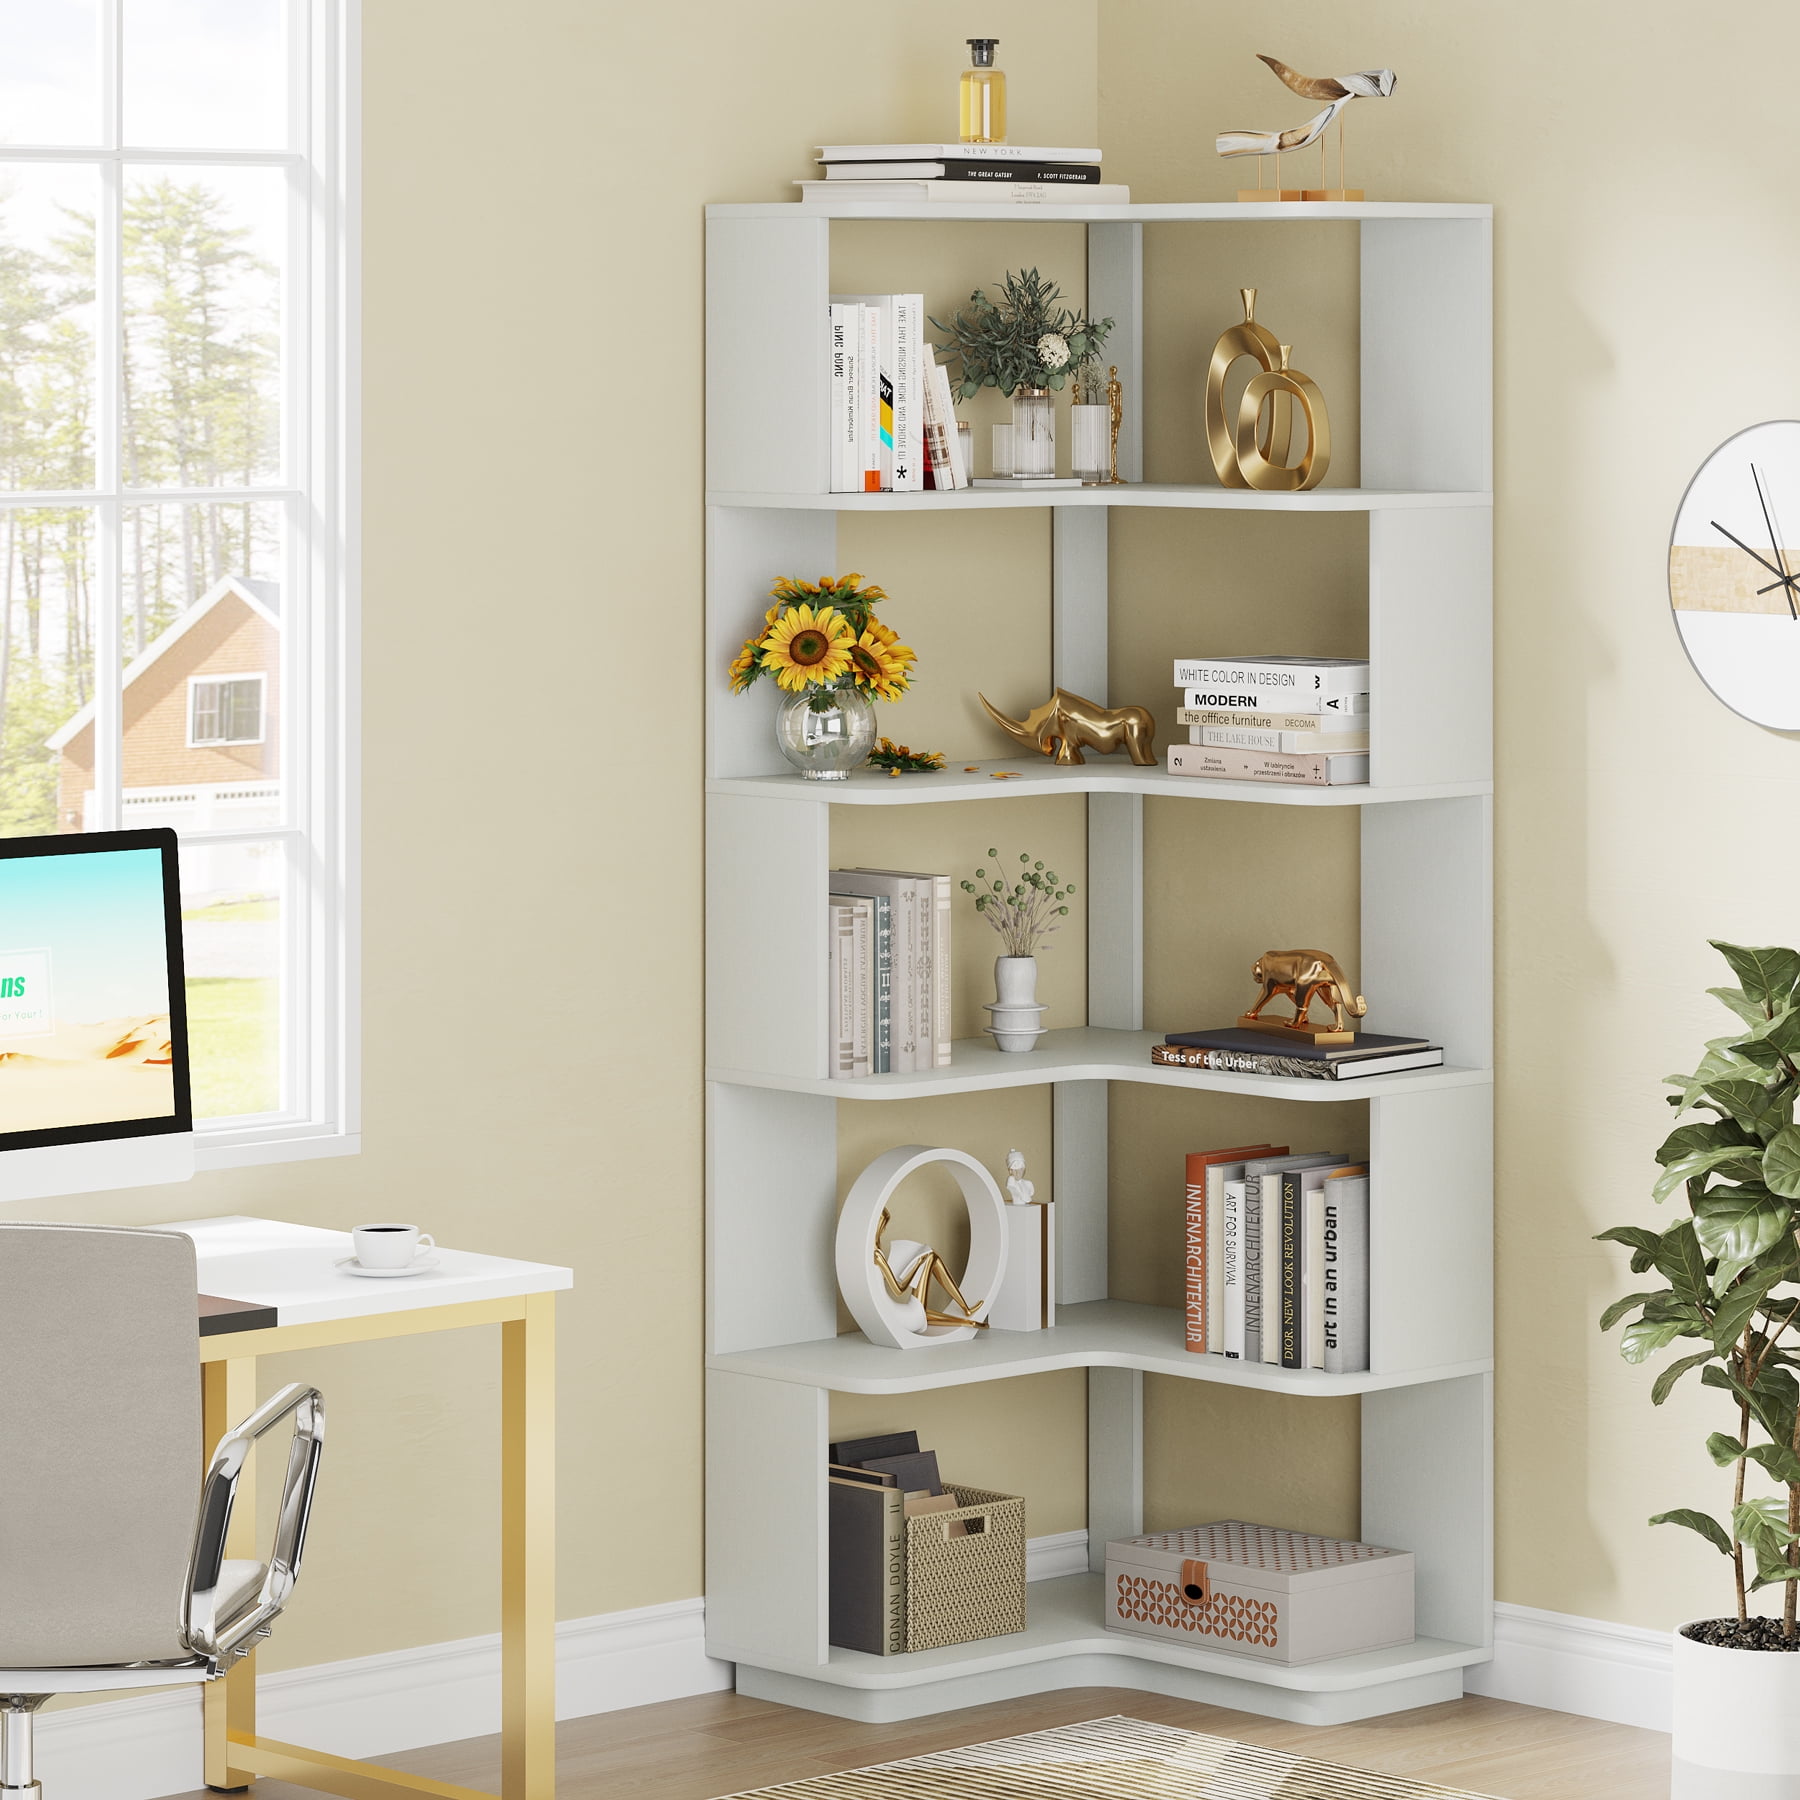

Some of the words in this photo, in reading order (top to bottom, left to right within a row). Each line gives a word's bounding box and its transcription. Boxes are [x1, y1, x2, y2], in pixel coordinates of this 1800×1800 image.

[963, 147, 987, 155] NEW
[994, 148, 1022, 156] YORK
[1179, 667, 1209, 682] WHITE
[1211, 669, 1245, 684] COLOR
[1247, 671, 1257, 684] IN
[1259, 672, 1295, 687] DESIGN
[1194, 694, 1257, 708] MODERN
[1326, 698, 1339, 710] A
[1184, 711, 1200, 723] the
[1232, 713, 1272, 728] furniture
[1285, 718, 1316, 729] DECOMA
[1208, 731, 1224, 743] THE
[1225, 732, 1247, 745] LAKE
[1248, 734, 1276, 748] HOUSE
[1173, 757, 1183, 767] 2
[0, 976, 25, 998] ns
[1161, 1051, 1186, 1063] Tess
[1189, 1053, 1202, 1064] of
[1204, 1054, 1222, 1066] the
[1225, 1057, 1258, 1069] Urber
[1225, 1193, 1237, 1213] ART
[1225, 1216, 1237, 1237] FOR
[1284, 1182, 1294, 1259] REVOLUTION
[1324, 1205, 1338, 1262] urban
[1186, 1183, 1202, 1343] INNENARCHITEKTUR
[1225, 1239, 1237, 1286] SURVIVAL
[1245, 1174, 1261, 1333] INNENARCHITEKTUR
[1284, 1261, 1294, 1296] LOOK
[1325, 1268, 1338, 1292] an
[1284, 1299, 1294, 1325] NEW
[1324, 1297, 1338, 1315] in
[1284, 1328, 1294, 1360] DIOR.
[1324, 1320, 1338, 1349] art
[889, 1534, 901, 1586] DOYLE
[889, 1594, 901, 1653] CONAN
